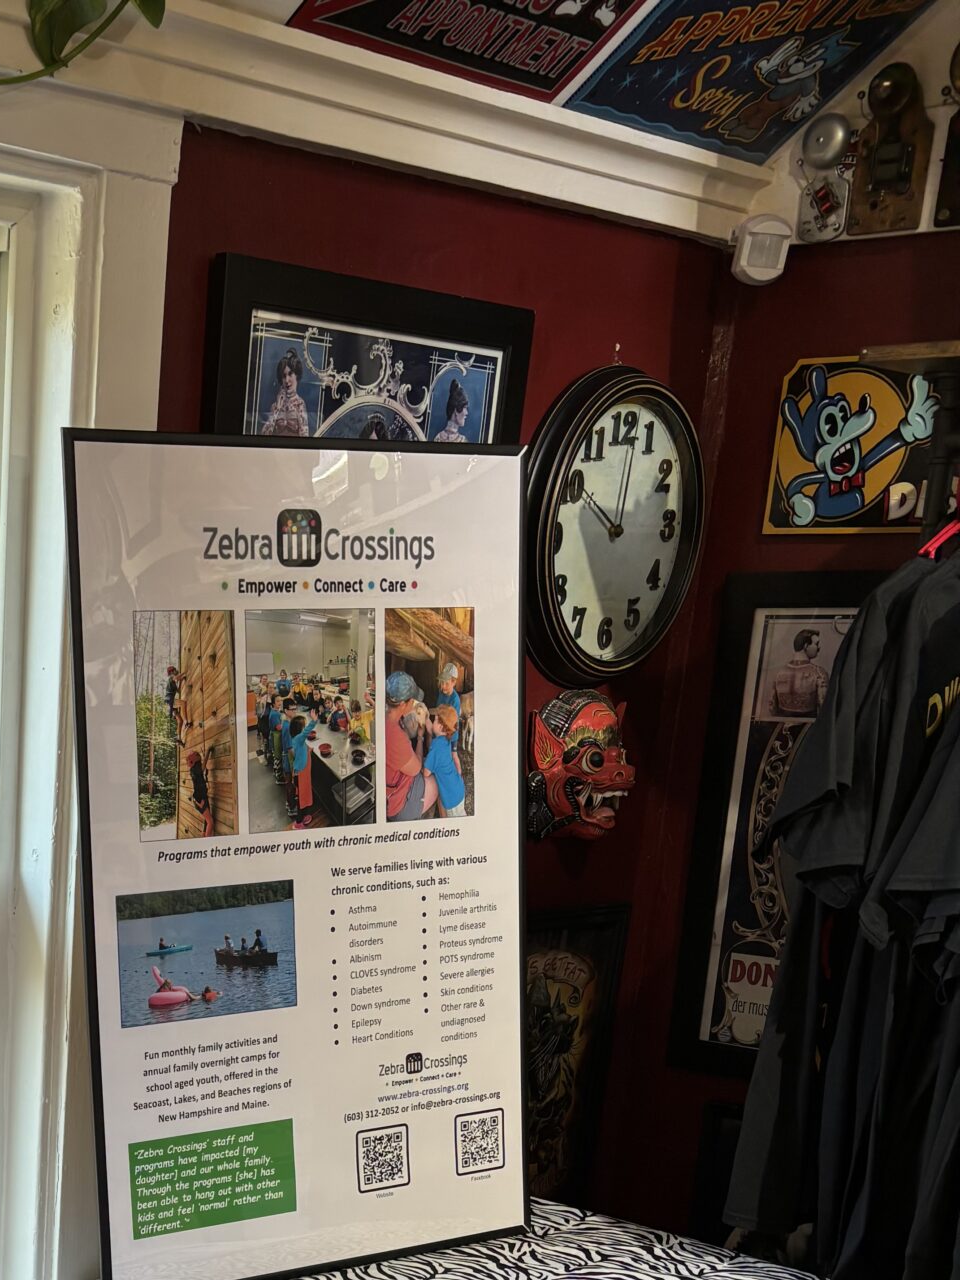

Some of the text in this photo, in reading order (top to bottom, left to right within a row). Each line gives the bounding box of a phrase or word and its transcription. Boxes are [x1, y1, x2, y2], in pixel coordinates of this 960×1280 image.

[388, 0, 593, 79] APPOINTMENT
[669, 54, 753, 129] Sorry
[581, 426, 605, 462] 11
[609, 411, 638, 446] 12
[642, 421, 655, 455] 1
[561, 469, 584, 504] 10
[655, 459, 672, 493] 2
[554, 522, 563, 554] 9
[660, 510, 675, 542] 3
[203, 527, 435, 568] Zebra Crossings
[238, 577, 407, 596] Empower Connect Care
[556, 574, 567, 606] 8
[646, 560, 661, 590] 4
[572, 607, 587, 639] 7
[624, 597, 640, 631] 5
[597, 617, 612, 649] 6
[157, 827, 460, 864] Programs that empower youth with chronic medical conditions
[330, 854, 488, 878] We serve families living with various
[331, 875, 450, 896] chronic conditions, such as:
[438, 888, 480, 901] Hemophilia
[348, 904, 377, 915] Asthma
[349, 953, 382, 964] Albinism
[563, 961, 586, 979] FAT
[350, 985, 383, 997] Diabetes
[731, 998, 745, 1013] der
[351, 1018, 382, 1030] Epilepsy
[144, 1033, 278, 1061] Fun monthly family activities and
[379, 1053, 468, 1077] Zebra Crossings
[343, 1091, 501, 1124] (603) 312-2052 or info@zebra-crossings.org
[377, 1082, 470, 1103] www.zebra-crossings.org
[158, 1099, 270, 1123] New Hampshire and Maine.
[211, 1134, 236, 1148] staff
[238, 1131, 255, 1143] and
